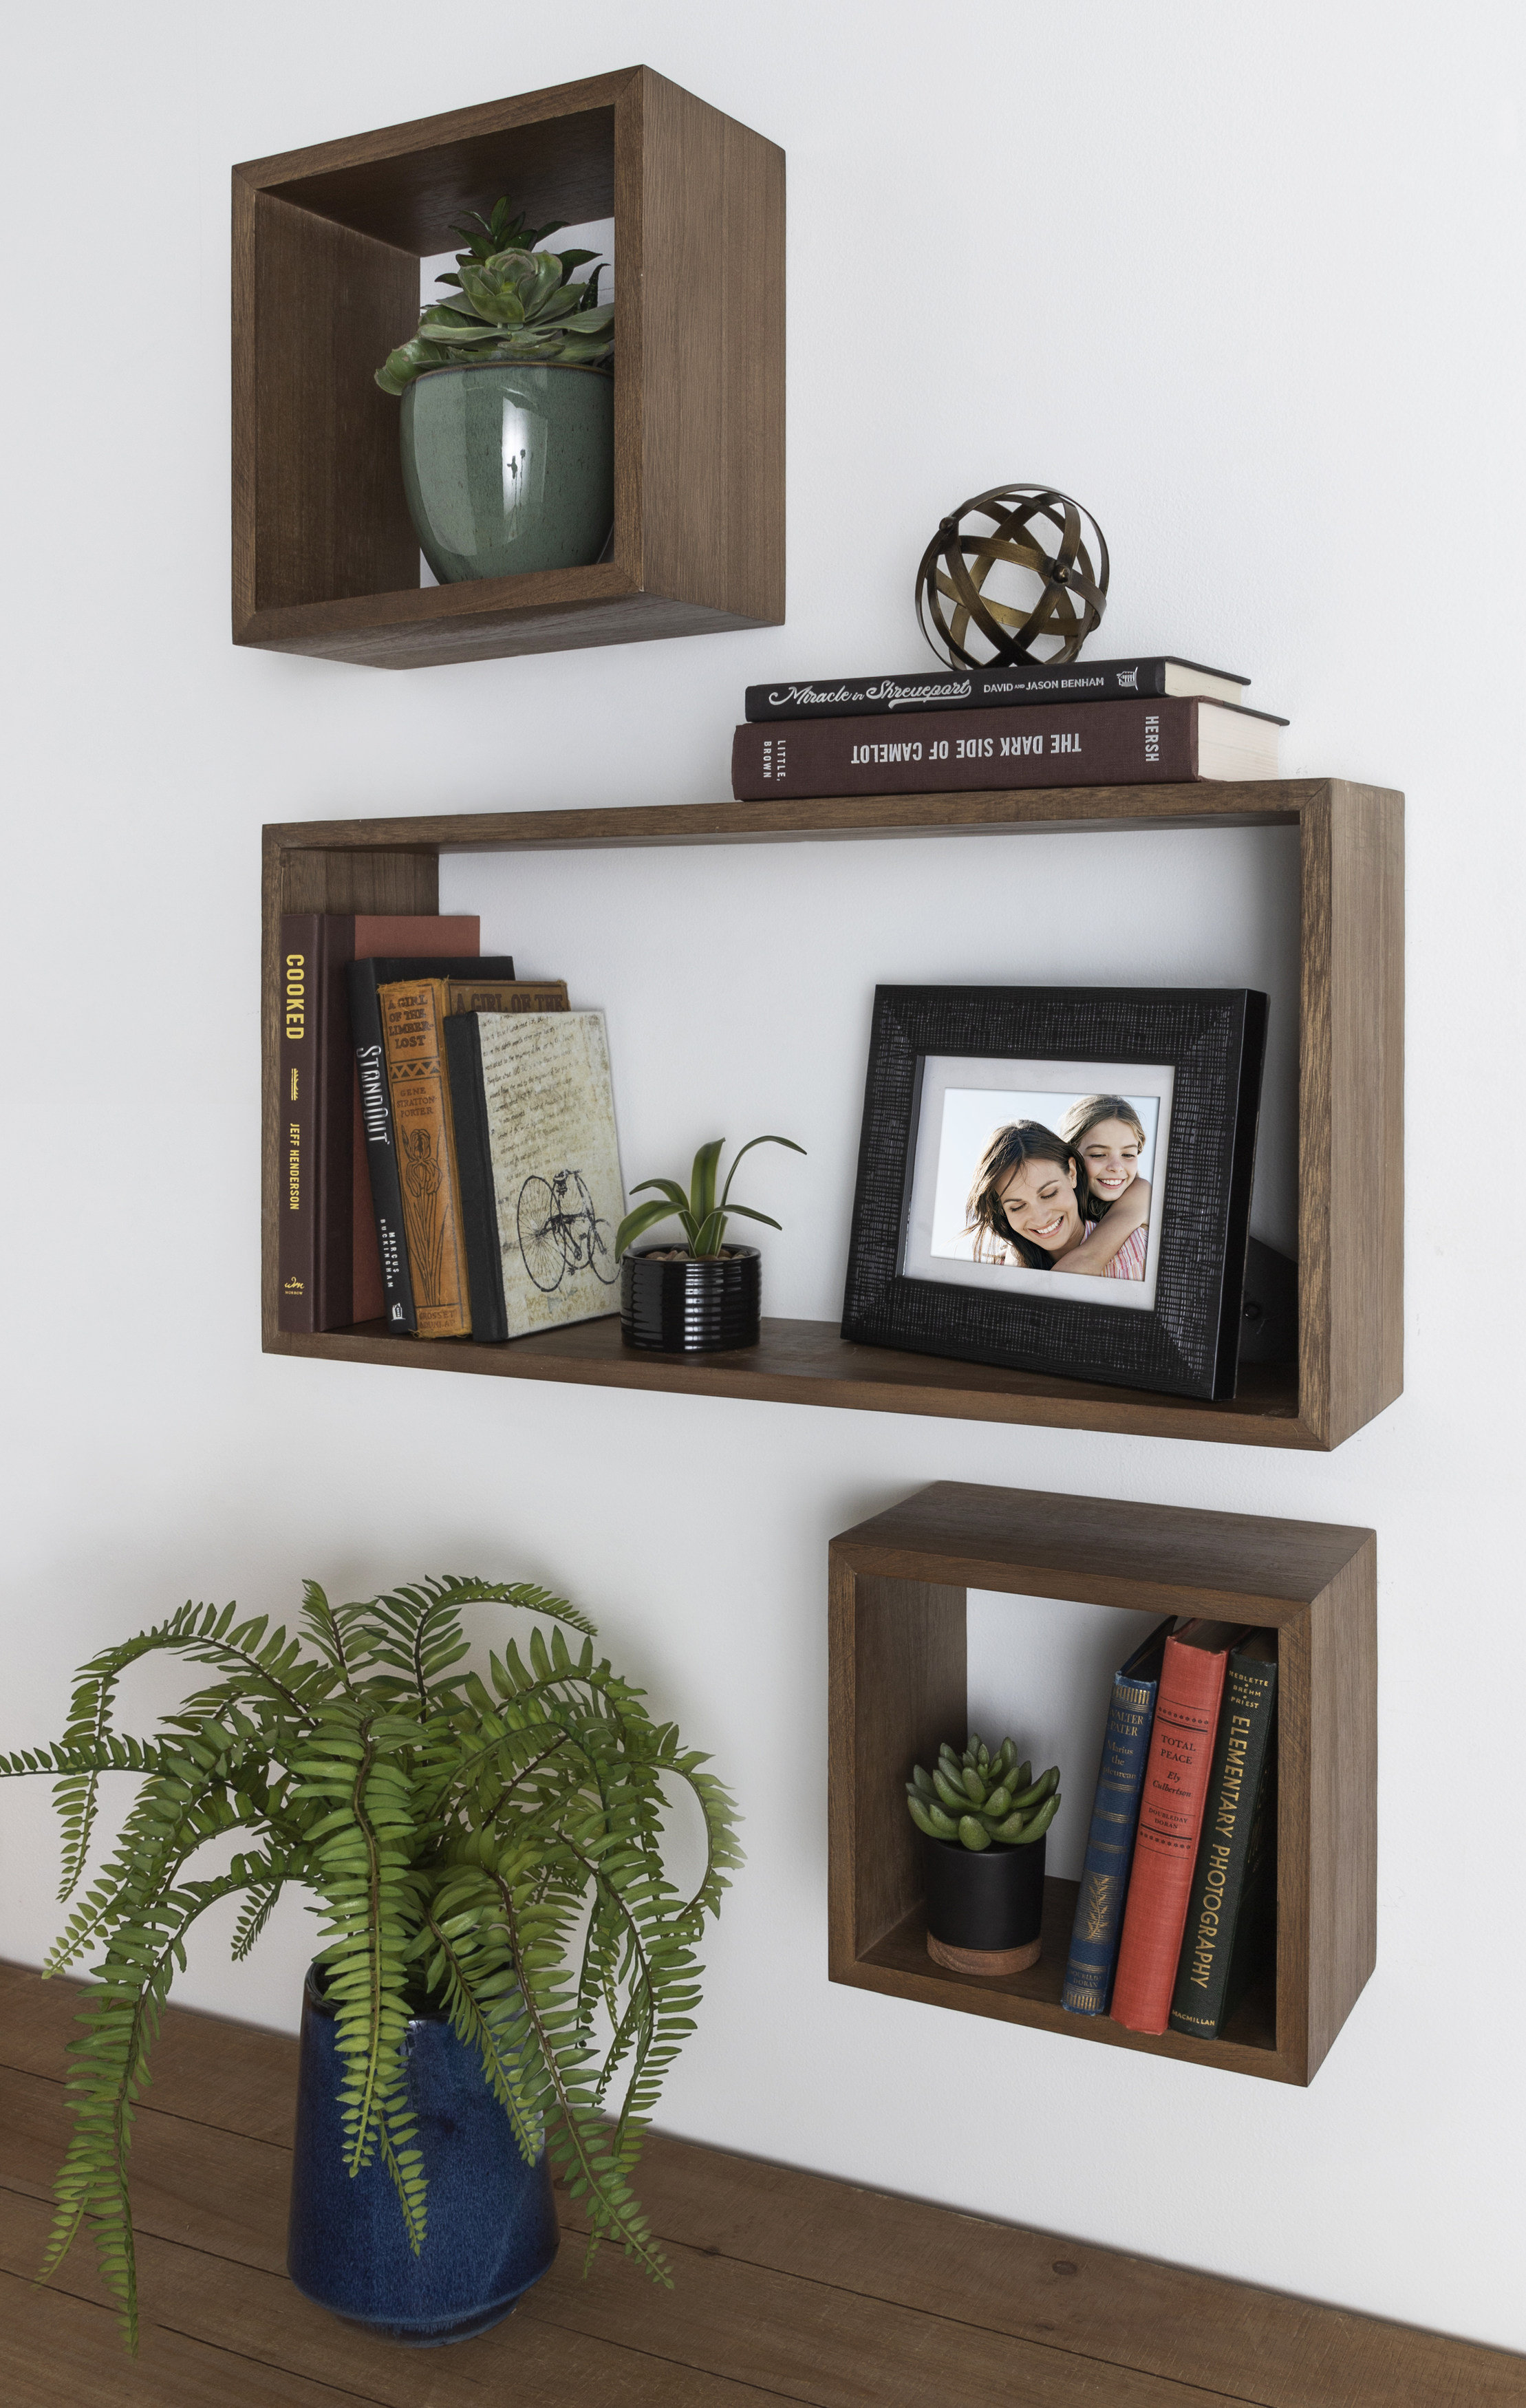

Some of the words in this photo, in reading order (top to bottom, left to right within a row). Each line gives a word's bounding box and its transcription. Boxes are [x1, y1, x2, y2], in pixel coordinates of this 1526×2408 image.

[983, 682, 1013, 694] DAVID
[1025, 680, 1059, 691] JASON
[1061, 677, 1104, 689] BENHAM
[769, 685, 851, 706] Miracle
[852, 692, 865, 701] in
[866, 679, 972, 710] Shreveport
[1000, 735, 1043, 756] DARK
[1050, 733, 1082, 753] THE
[1145, 716, 1159, 762] HERSH
[850, 742, 923, 764] CAMELOT
[928, 740, 949, 760] OF
[956, 738, 993, 759] SIDE
[762, 740, 772, 779] BROWN
[776, 740, 786, 782] LITTLE,
[286, 954, 305, 1040] COOKED
[388, 1000, 396, 1010] A
[397, 994, 428, 1009] GIRL
[389, 1011, 402, 1023] OF
[404, 1009, 427, 1020] THE
[389, 1021, 434, 1036] LIMBER-
[395, 1035, 427, 1049] LOST
[400, 1087, 426, 1097] GENE
[400, 1107, 433, 1119] PORTER
[290, 1123, 300, 1146] JEFF
[290, 1150, 300, 1210] HENDERSON
[380, 1219, 394, 1287] BUCKINGHAM
[389, 1232, 399, 1272] MARCUS
[1229, 1670, 1269, 1686] NEBLETTE
[1233, 1684, 1261, 1697] BREHM
[1231, 1696, 1259, 1708] PRIEST
[1110, 1720, 1138, 1737] PATER
[1107, 1739, 1134, 1755] Marius
[1161, 1734, 1196, 1752] TOTAL
[1111, 1755, 1125, 1766] the
[1160, 1748, 1192, 1765] PEACE
[1102, 1766, 1137, 1780] picurean
[1167, 1771, 1181, 1783] Ely
[1215, 1714, 1251, 1838] ELEMENTARY
[1152, 1780, 1192, 1798] Culbertson
[1148, 1807, 1188, 1824] DOUBLEDAY
[1154, 1818, 1179, 1830] DORAN
[1190, 1844, 1230, 1988] PHOTOGRAPHY
[1172, 2010, 1215, 2026] MACMILLAN
